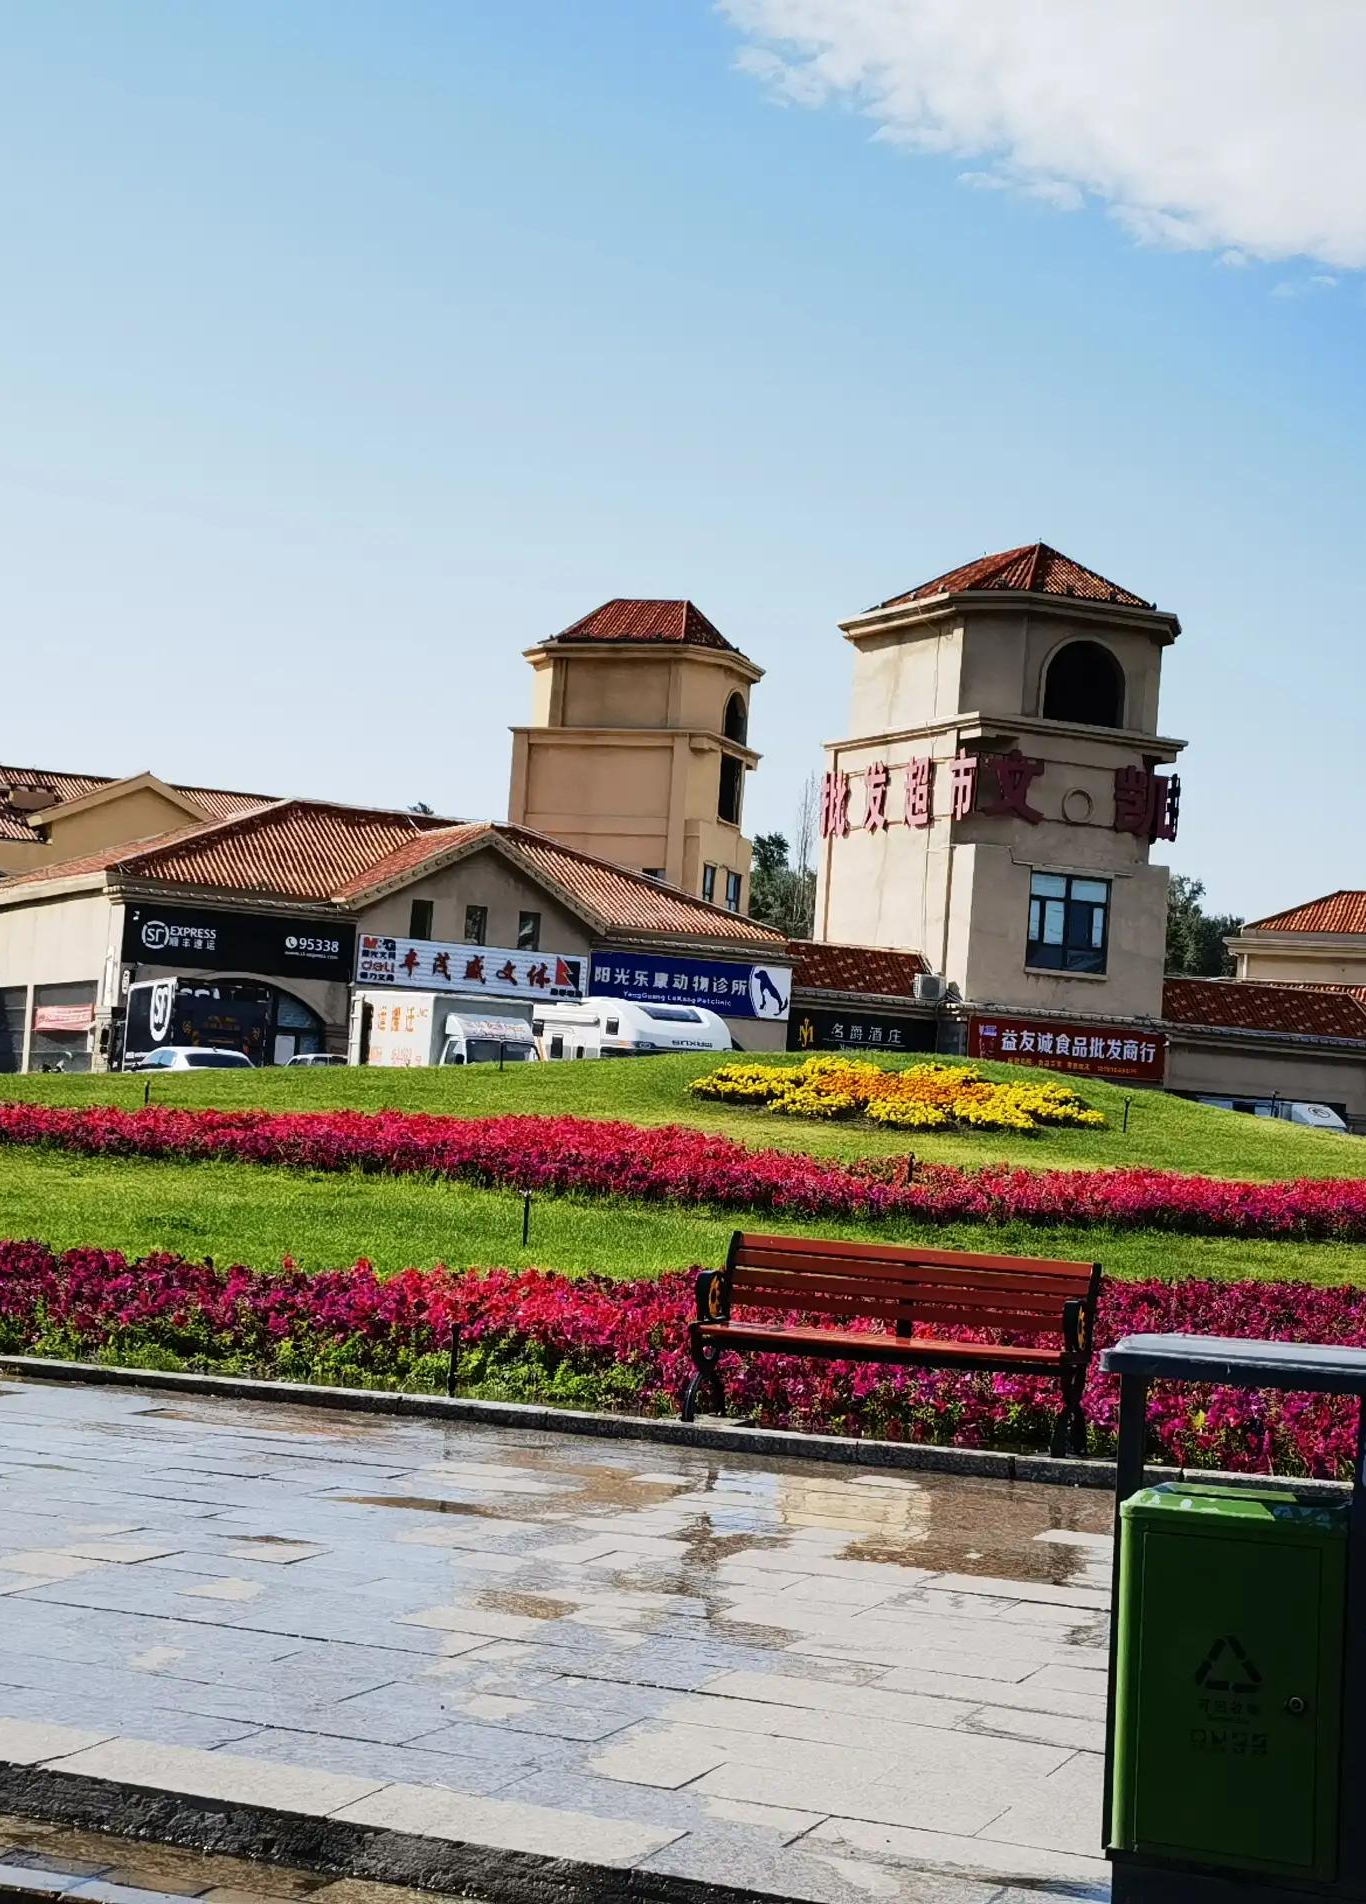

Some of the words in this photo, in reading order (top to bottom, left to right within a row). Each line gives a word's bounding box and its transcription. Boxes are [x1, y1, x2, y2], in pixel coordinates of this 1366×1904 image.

[821, 747, 977, 839] 批发超市
[170, 925, 217, 940] EXPRESS
[299, 937, 339, 953] 95338
[594, 966, 748, 997] 阳光乐康动物诊所
[830, 1022, 902, 1044] 名爵酒庄
[1001, 1028, 1156, 1064] 益友诚食品批发商行
